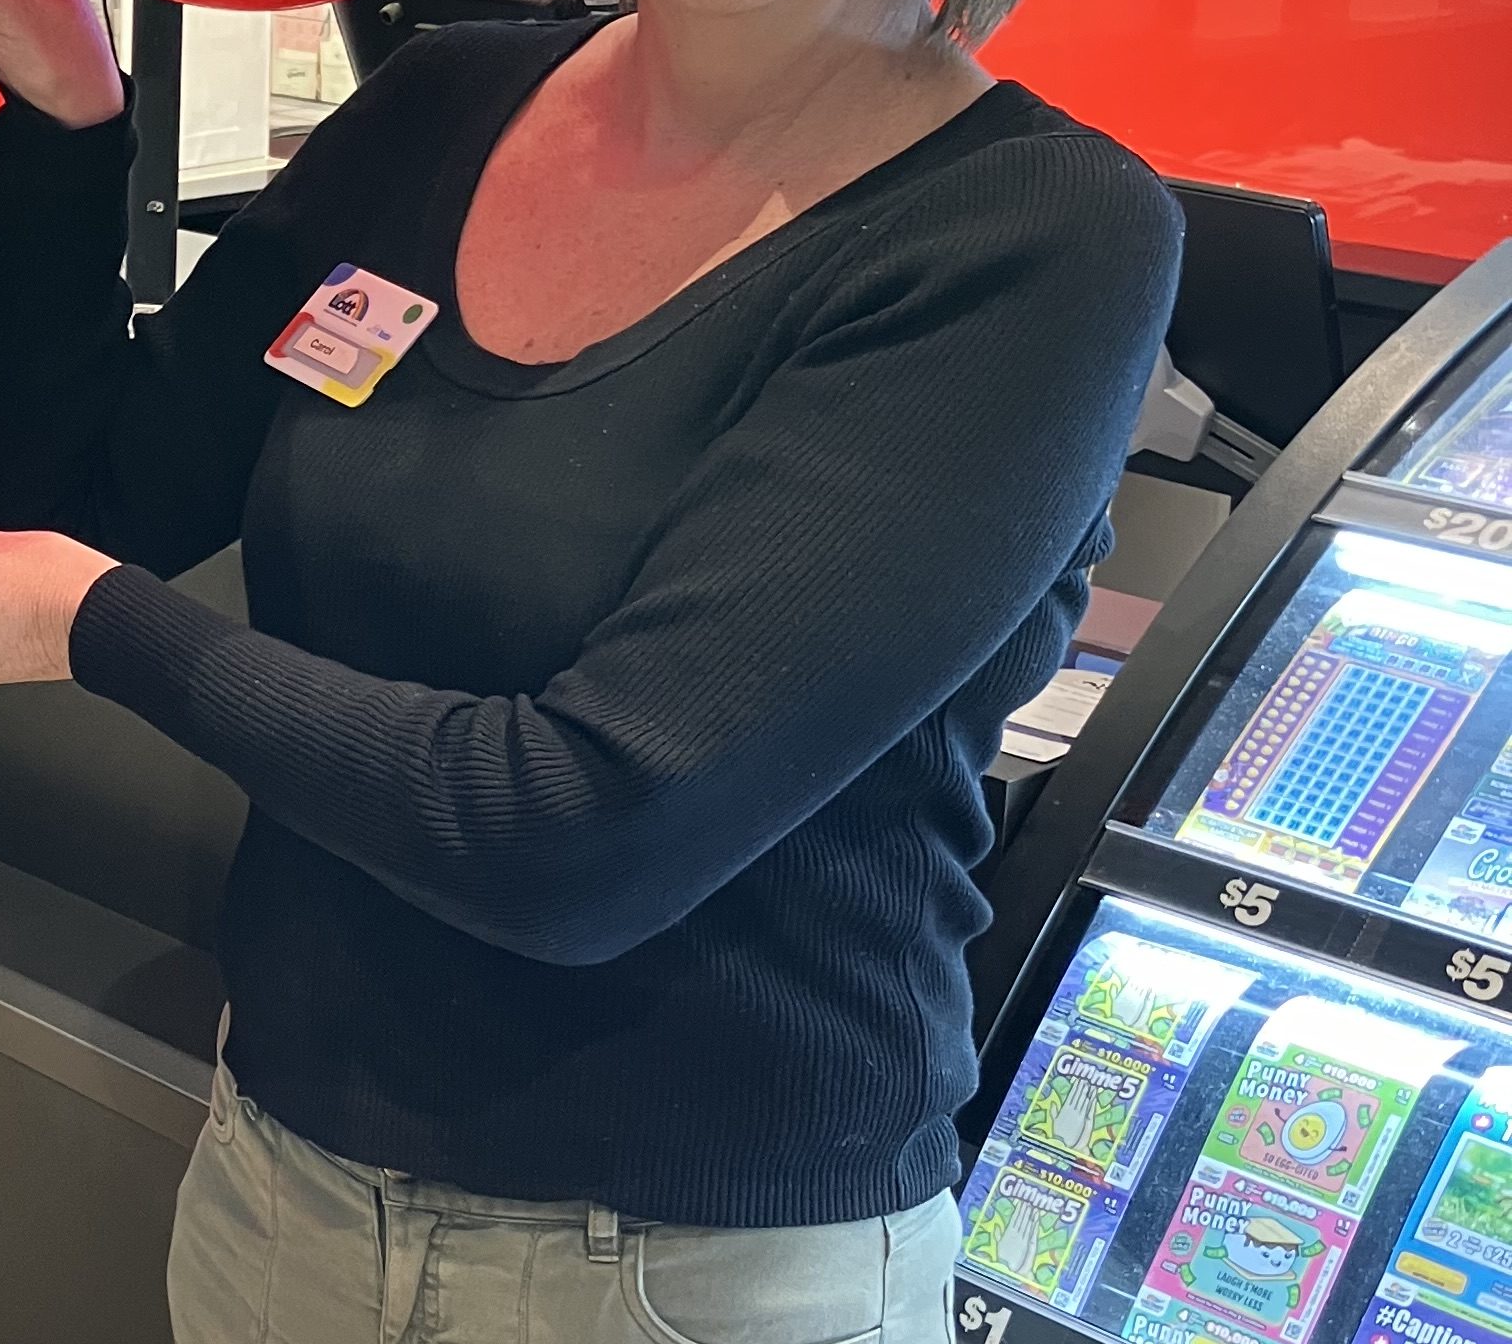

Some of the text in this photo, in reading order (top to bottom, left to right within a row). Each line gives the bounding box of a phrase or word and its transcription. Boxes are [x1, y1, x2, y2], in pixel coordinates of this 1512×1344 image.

[328, 294, 356, 316] Lott
[309, 338, 337, 356] Carol
[1423, 507, 1512, 551] $20
[1368, 627, 1420, 647] BINGO
[1468, 848, 1512, 886] Cro
[1219, 877, 1280, 927] $5
[1446, 948, 1511, 1002] $5
[1056, 1053, 1139, 1102] Gimme 5
[1246, 1060, 1311, 1088] Punny
[1238, 1078, 1308, 1106] Money
[1275, 1156, 1319, 1180] EGG-CITED
[998, 1173, 1083, 1224] Gimme 5
[1190, 1186, 1253, 1215] Punny
[1181, 1206, 1250, 1235] Money
[1446, 1231, 1461, 1249] 2
